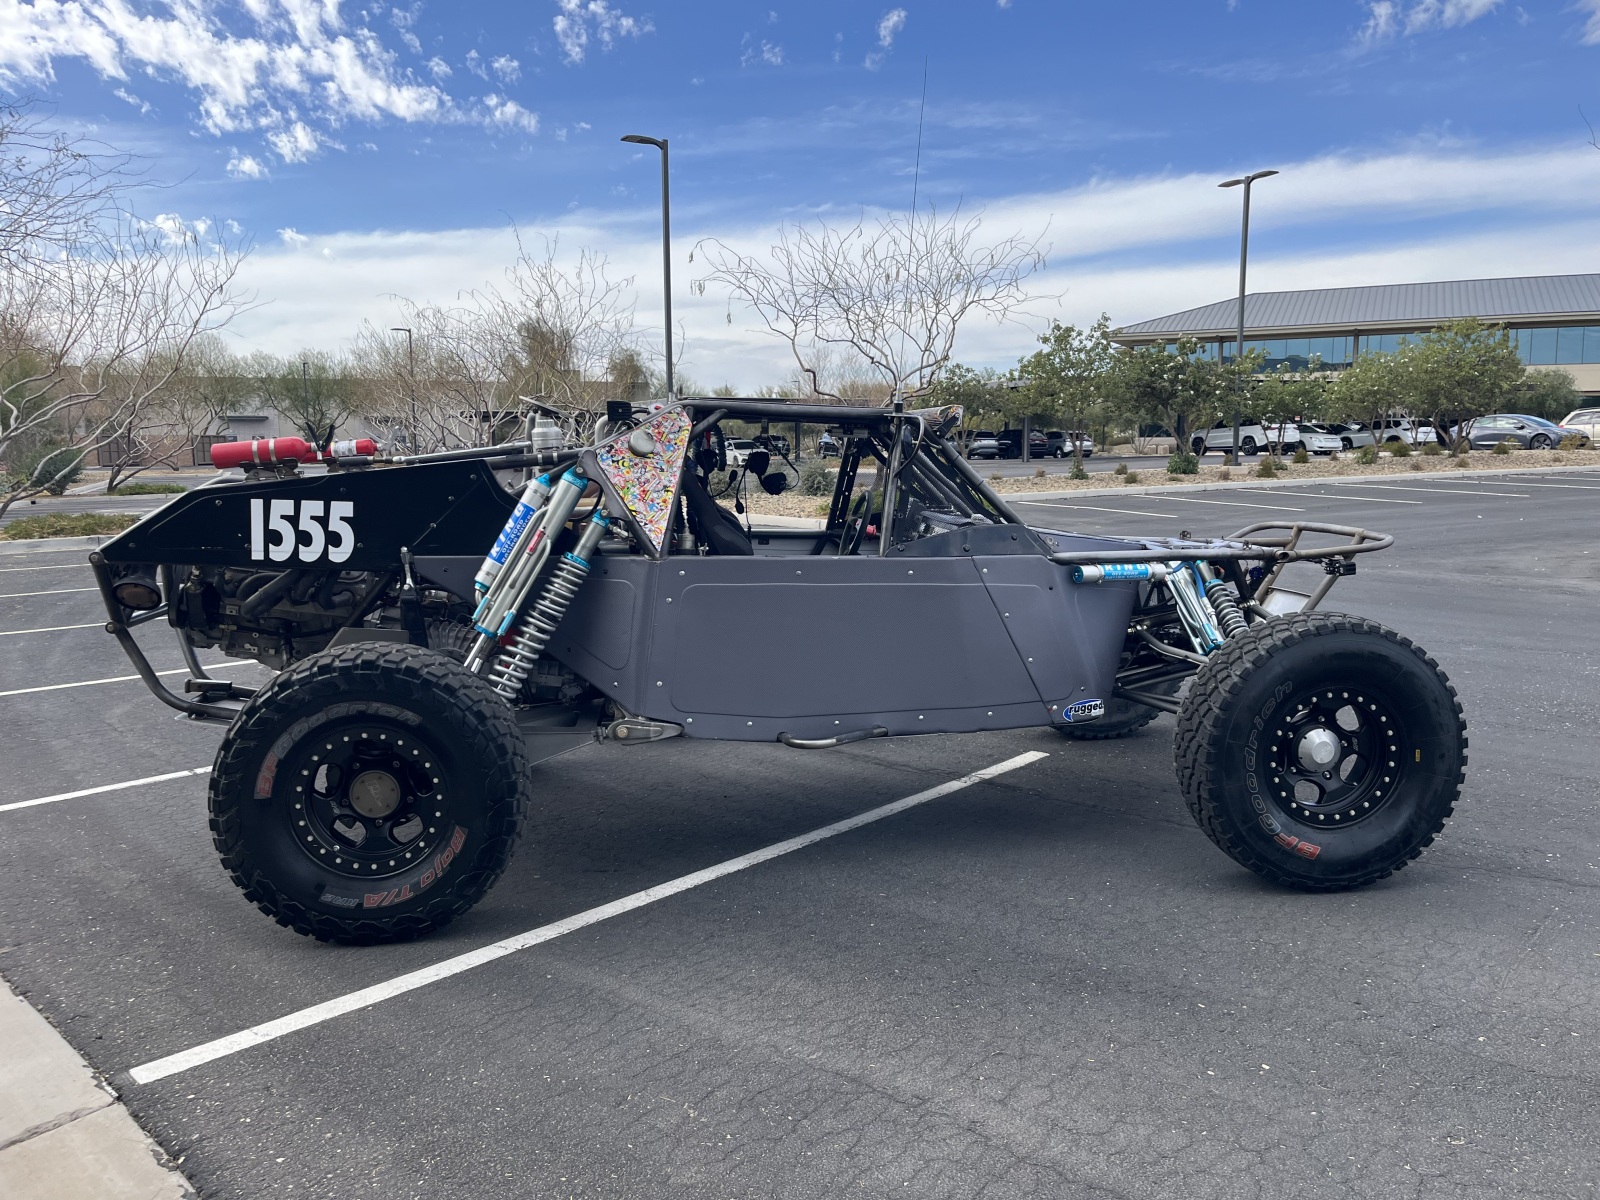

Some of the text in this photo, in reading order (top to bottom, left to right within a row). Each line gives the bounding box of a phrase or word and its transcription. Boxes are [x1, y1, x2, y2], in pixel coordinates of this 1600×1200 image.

[250, 498, 355, 563] 1555
[490, 503, 525, 558] KING
[502, 519, 524, 553] OFF-ROAD
[1105, 563, 1146, 571] KING
[1069, 701, 1103, 714] rugged
[255, 701, 422, 798] BFGoodrich
[1245, 681, 1321, 860] BFGoodrich
[421, 826, 467, 887] Baja
[363, 885, 413, 907] T/A
